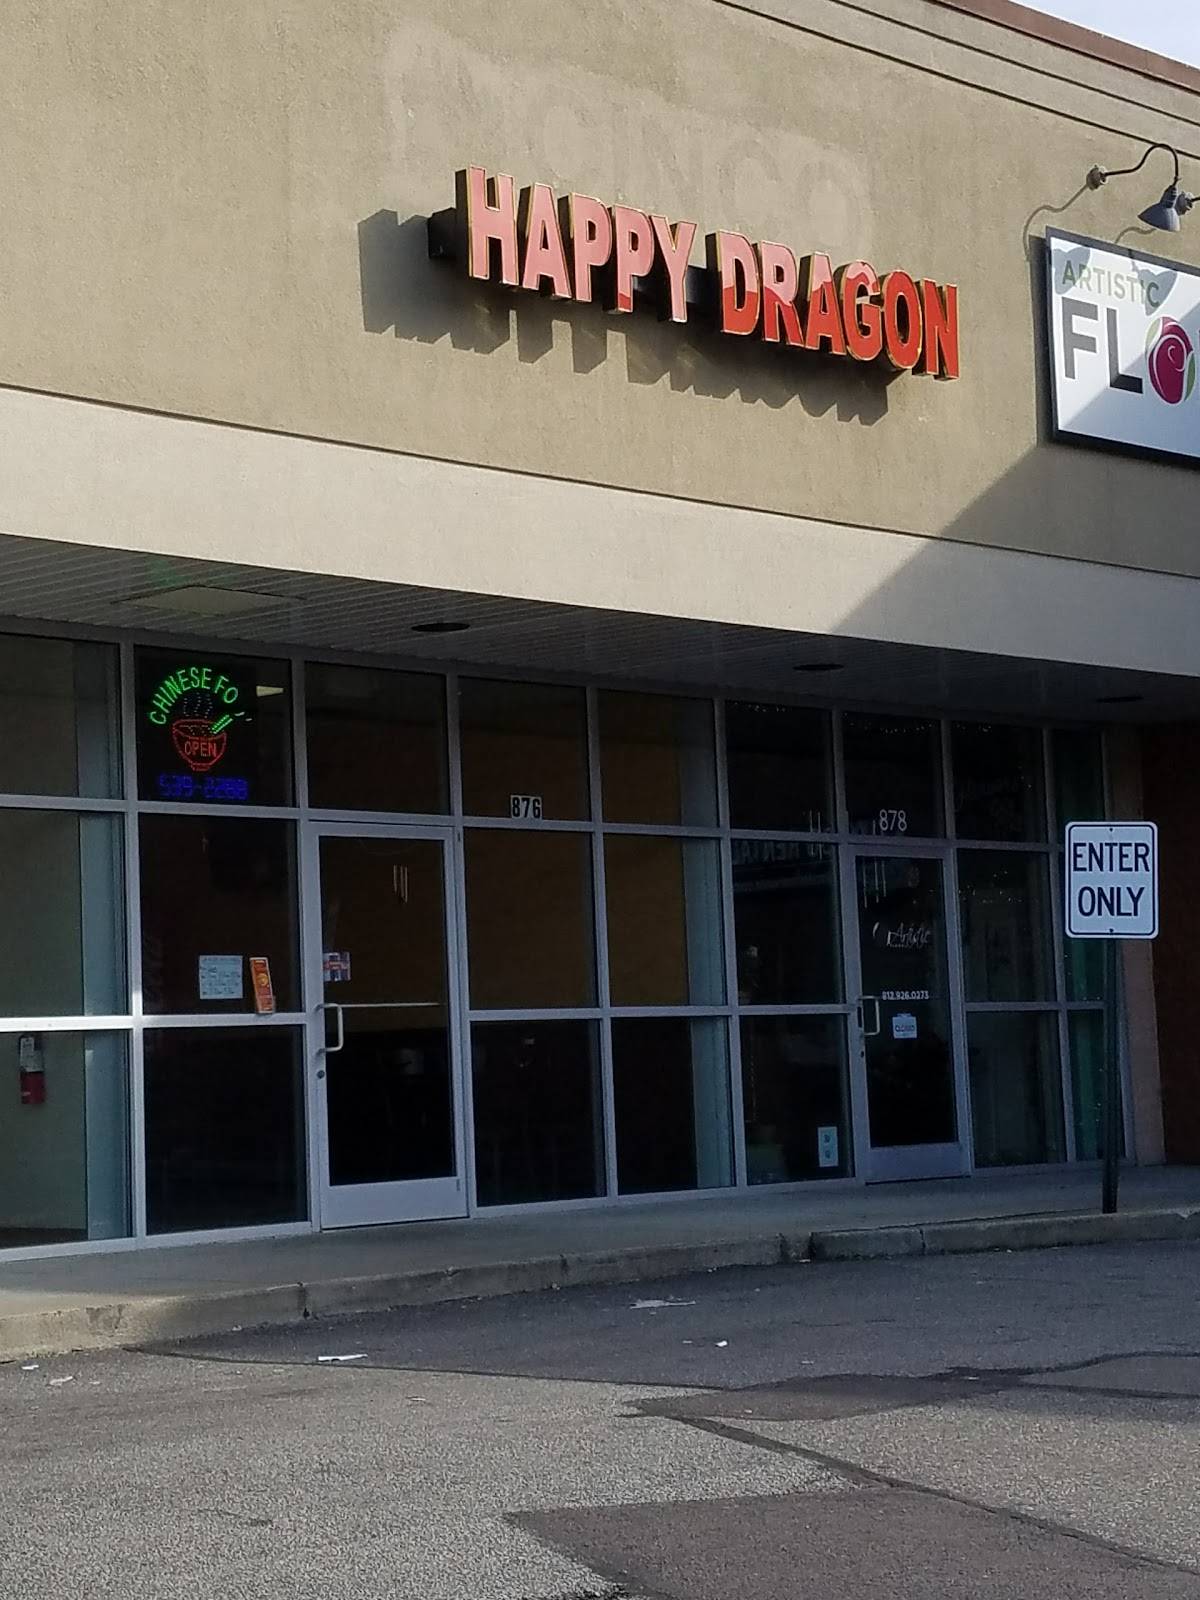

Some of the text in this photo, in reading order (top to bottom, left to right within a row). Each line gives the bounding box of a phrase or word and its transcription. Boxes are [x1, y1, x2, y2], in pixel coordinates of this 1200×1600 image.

[462, 164, 698, 323] HAPPY
[712, 230, 960, 380] DRAGON
[1061, 259, 1160, 308] ARTISTIC
[149, 666, 213, 725] CHINESE
[184, 740, 217, 758] OPEN
[511, 796, 541, 818] 876
[879, 809, 908, 832] 878
[1072, 842, 1150, 872] ENTER
[1077, 886, 1145, 917] ONLY
